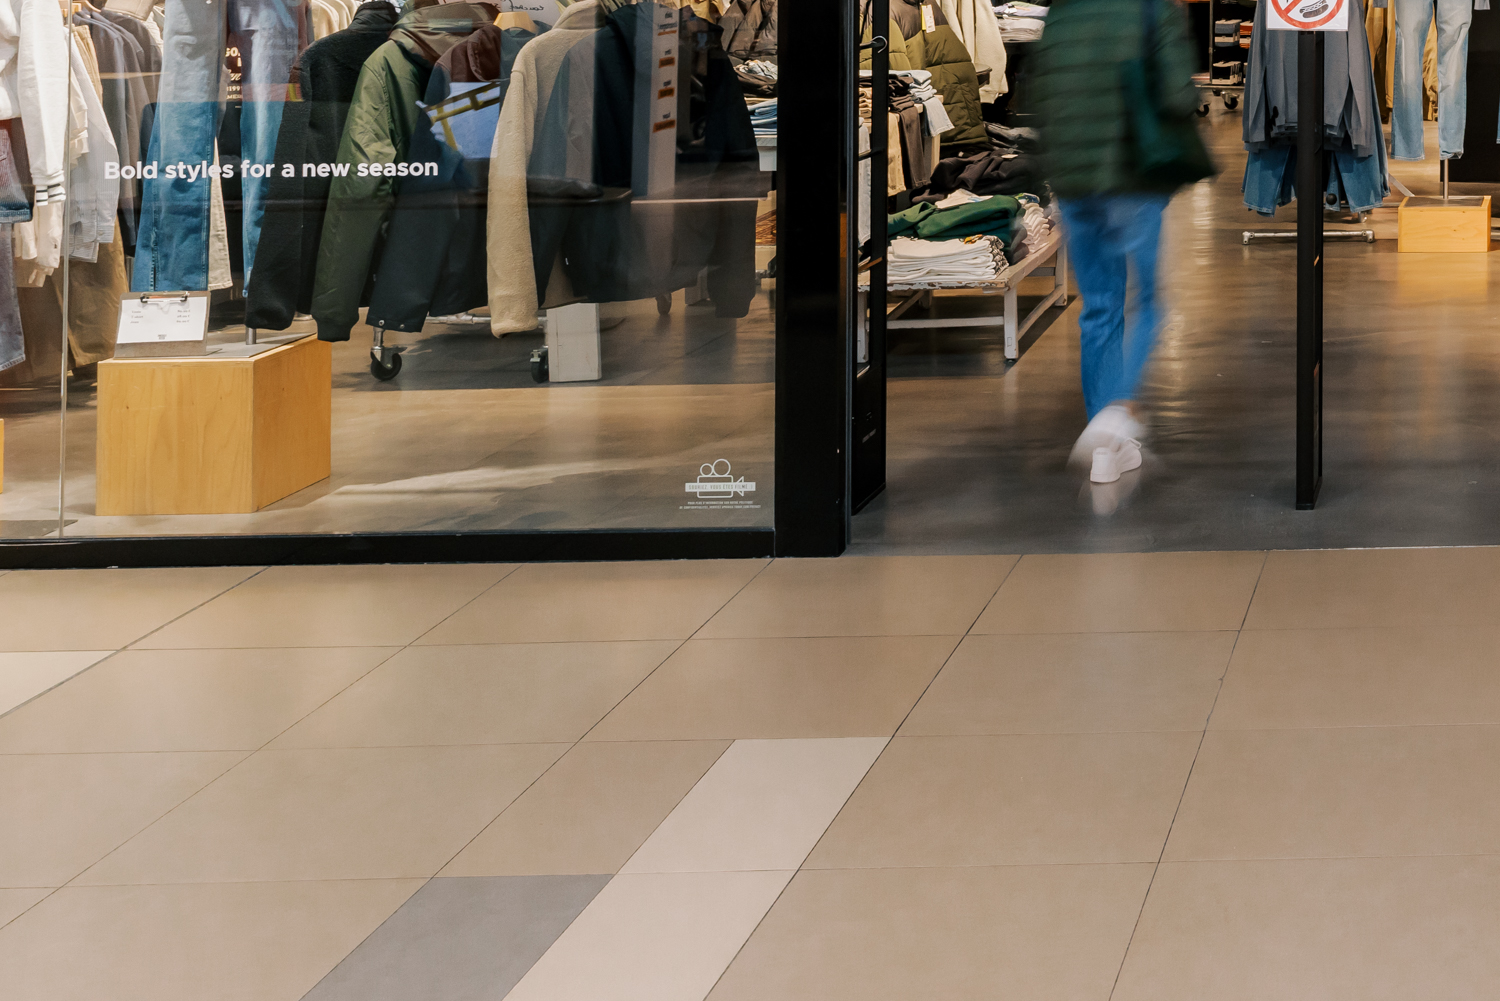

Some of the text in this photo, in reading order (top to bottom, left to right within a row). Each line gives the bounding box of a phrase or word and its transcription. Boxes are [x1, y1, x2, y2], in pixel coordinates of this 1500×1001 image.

[104, 159, 440, 183] Bold styles for a new season
